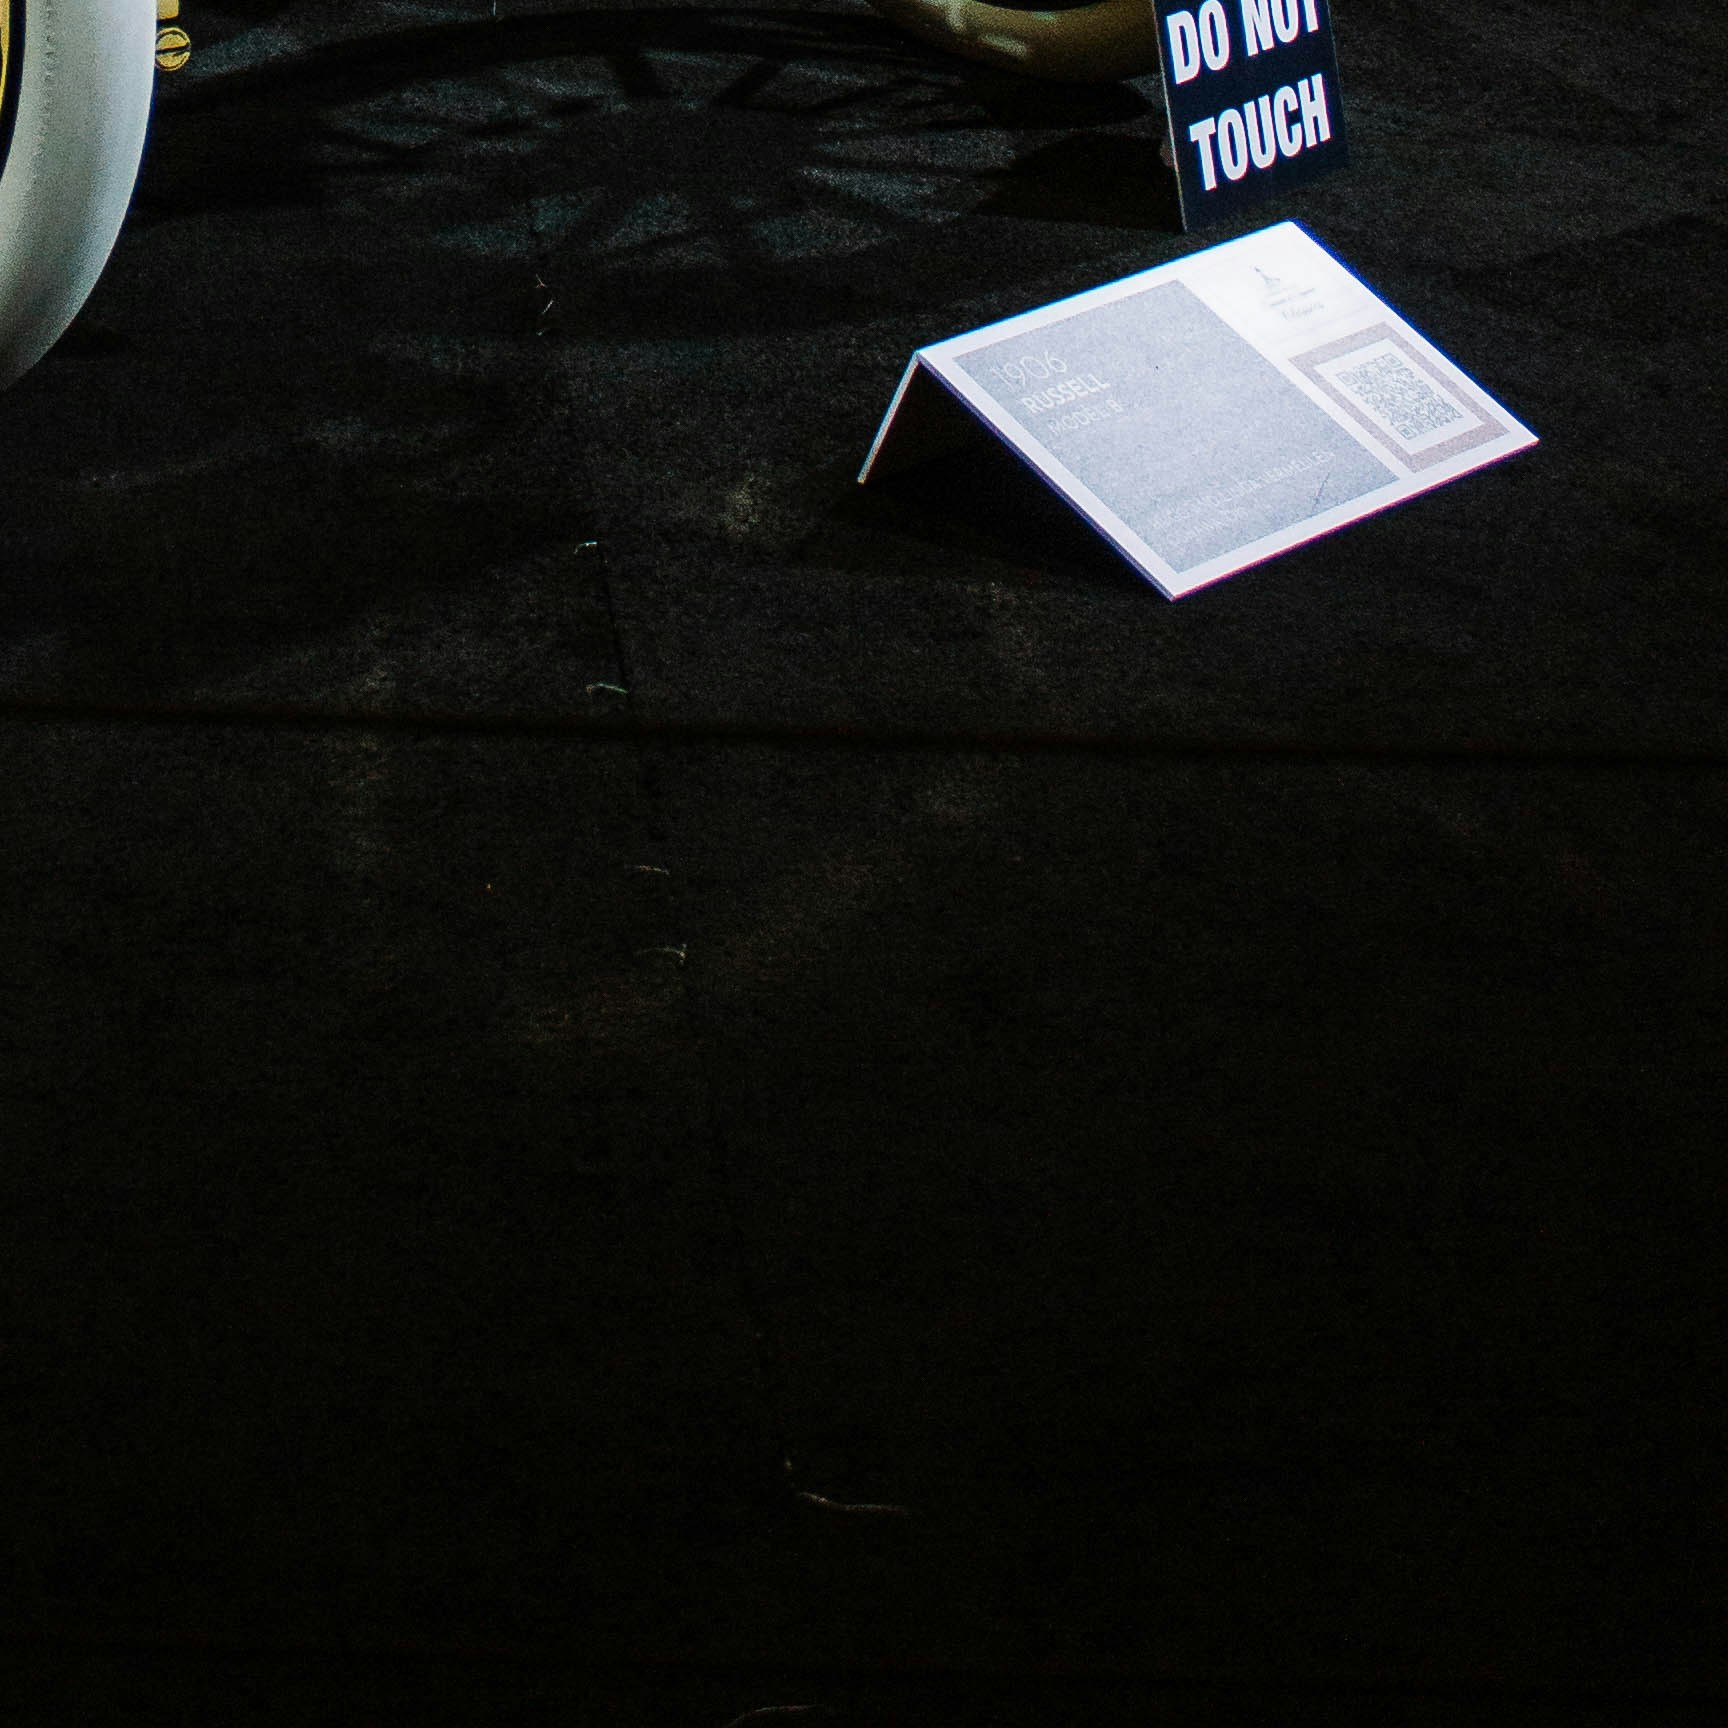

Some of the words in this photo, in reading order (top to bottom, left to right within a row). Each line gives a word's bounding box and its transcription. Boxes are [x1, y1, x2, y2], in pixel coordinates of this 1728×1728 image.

[1189, 73, 1332, 192] TOUCH
[989, 349, 1069, 391] 1906
[1020, 372, 1111, 414] RUSSELL
[1045, 403, 1111, 436] MODEL
